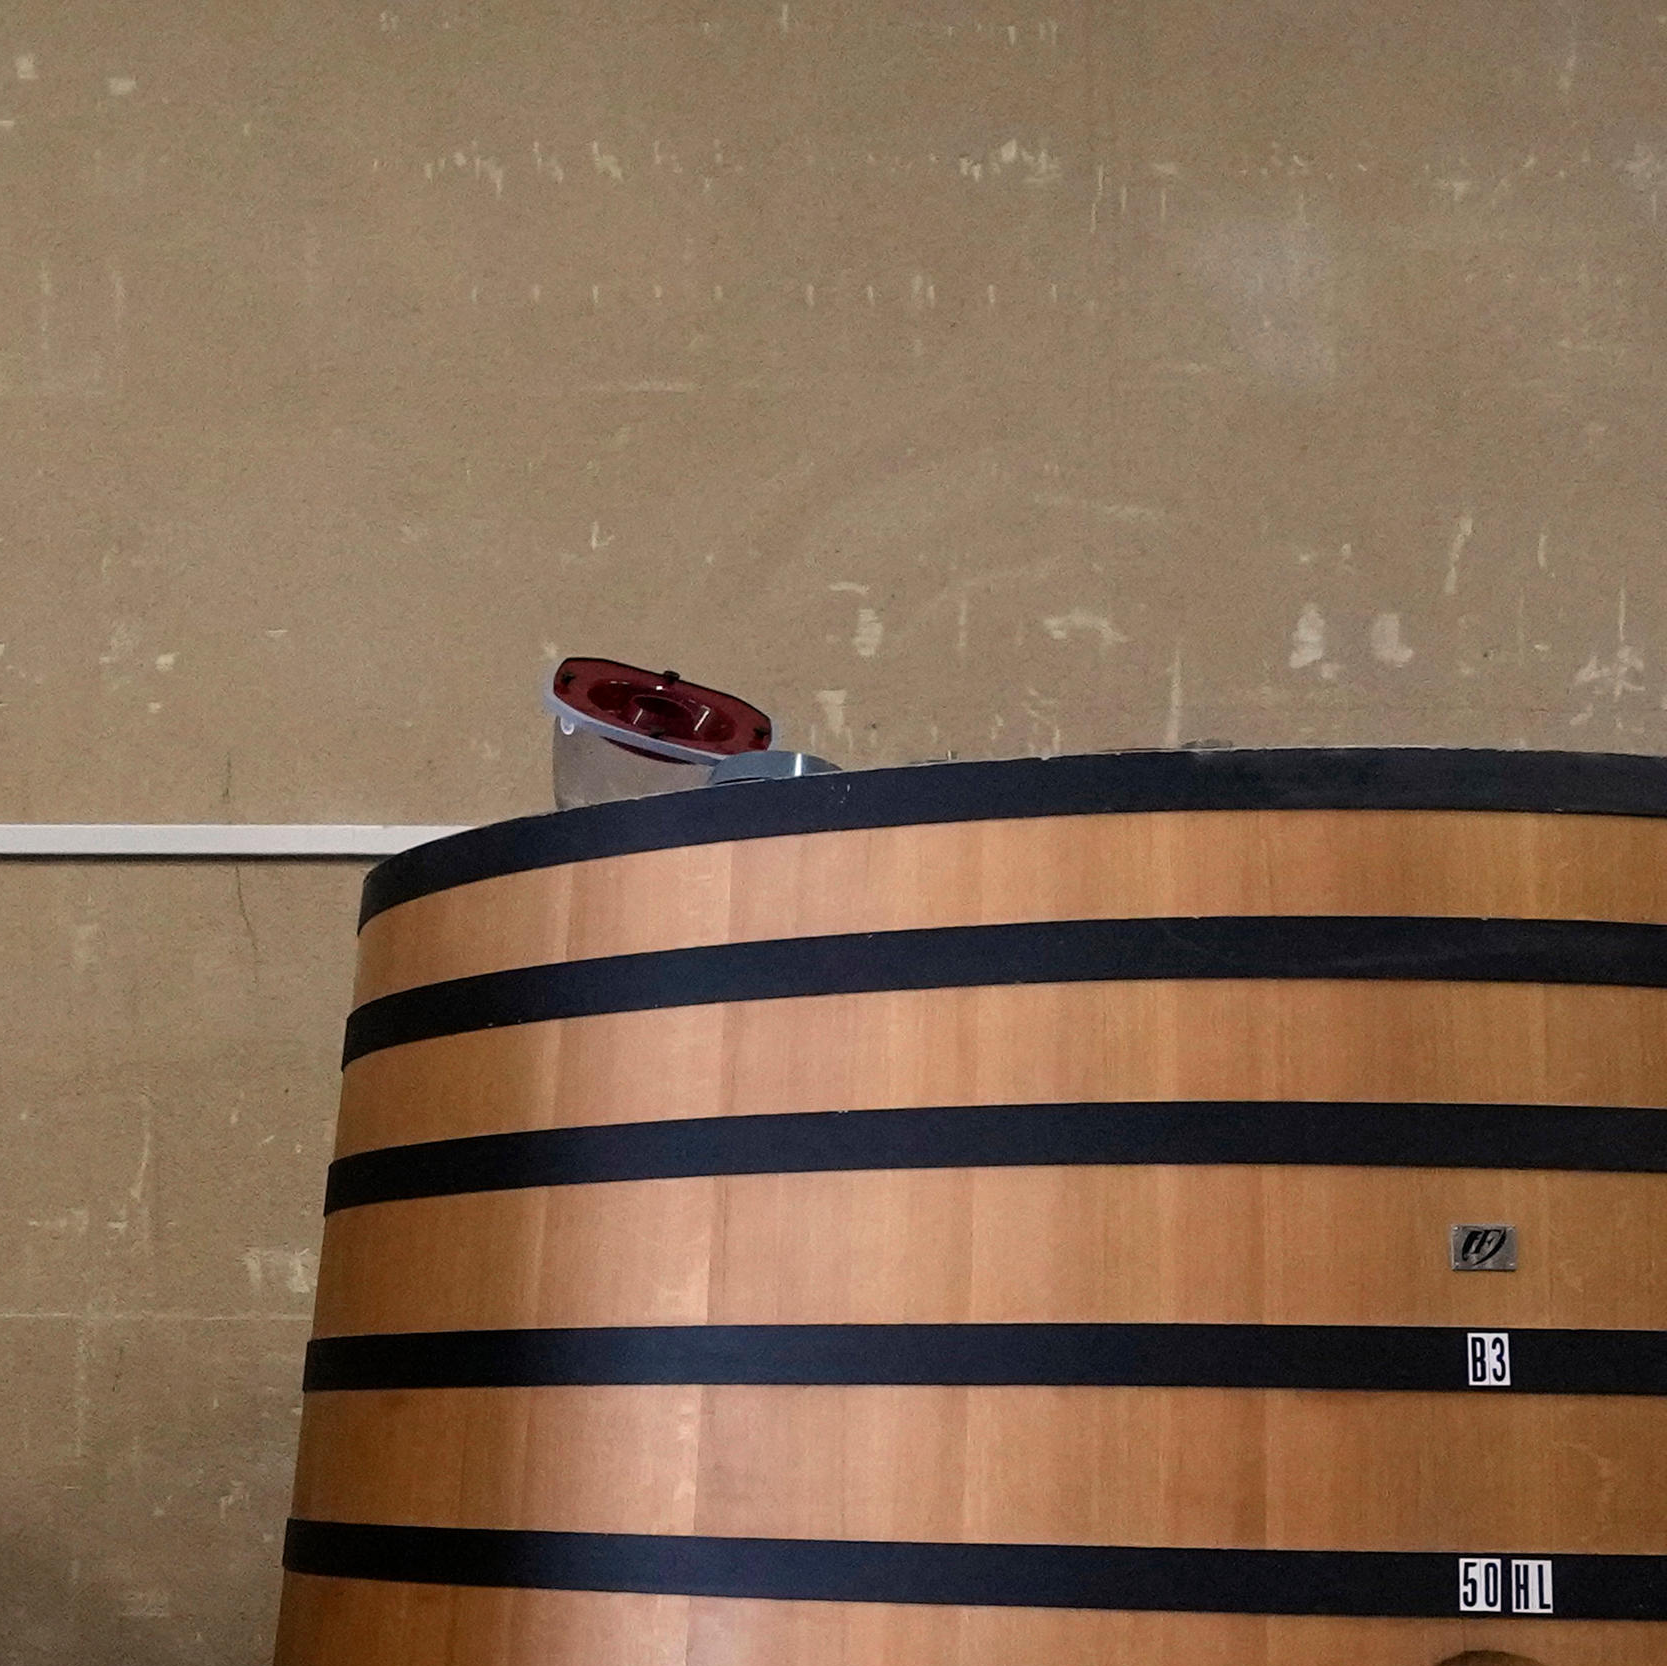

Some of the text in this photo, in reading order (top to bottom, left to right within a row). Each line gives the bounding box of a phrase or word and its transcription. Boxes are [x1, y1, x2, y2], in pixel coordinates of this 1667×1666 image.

[1471, 1336, 1507, 1382] B3
[1463, 1562, 1551, 1610] 50 HL
